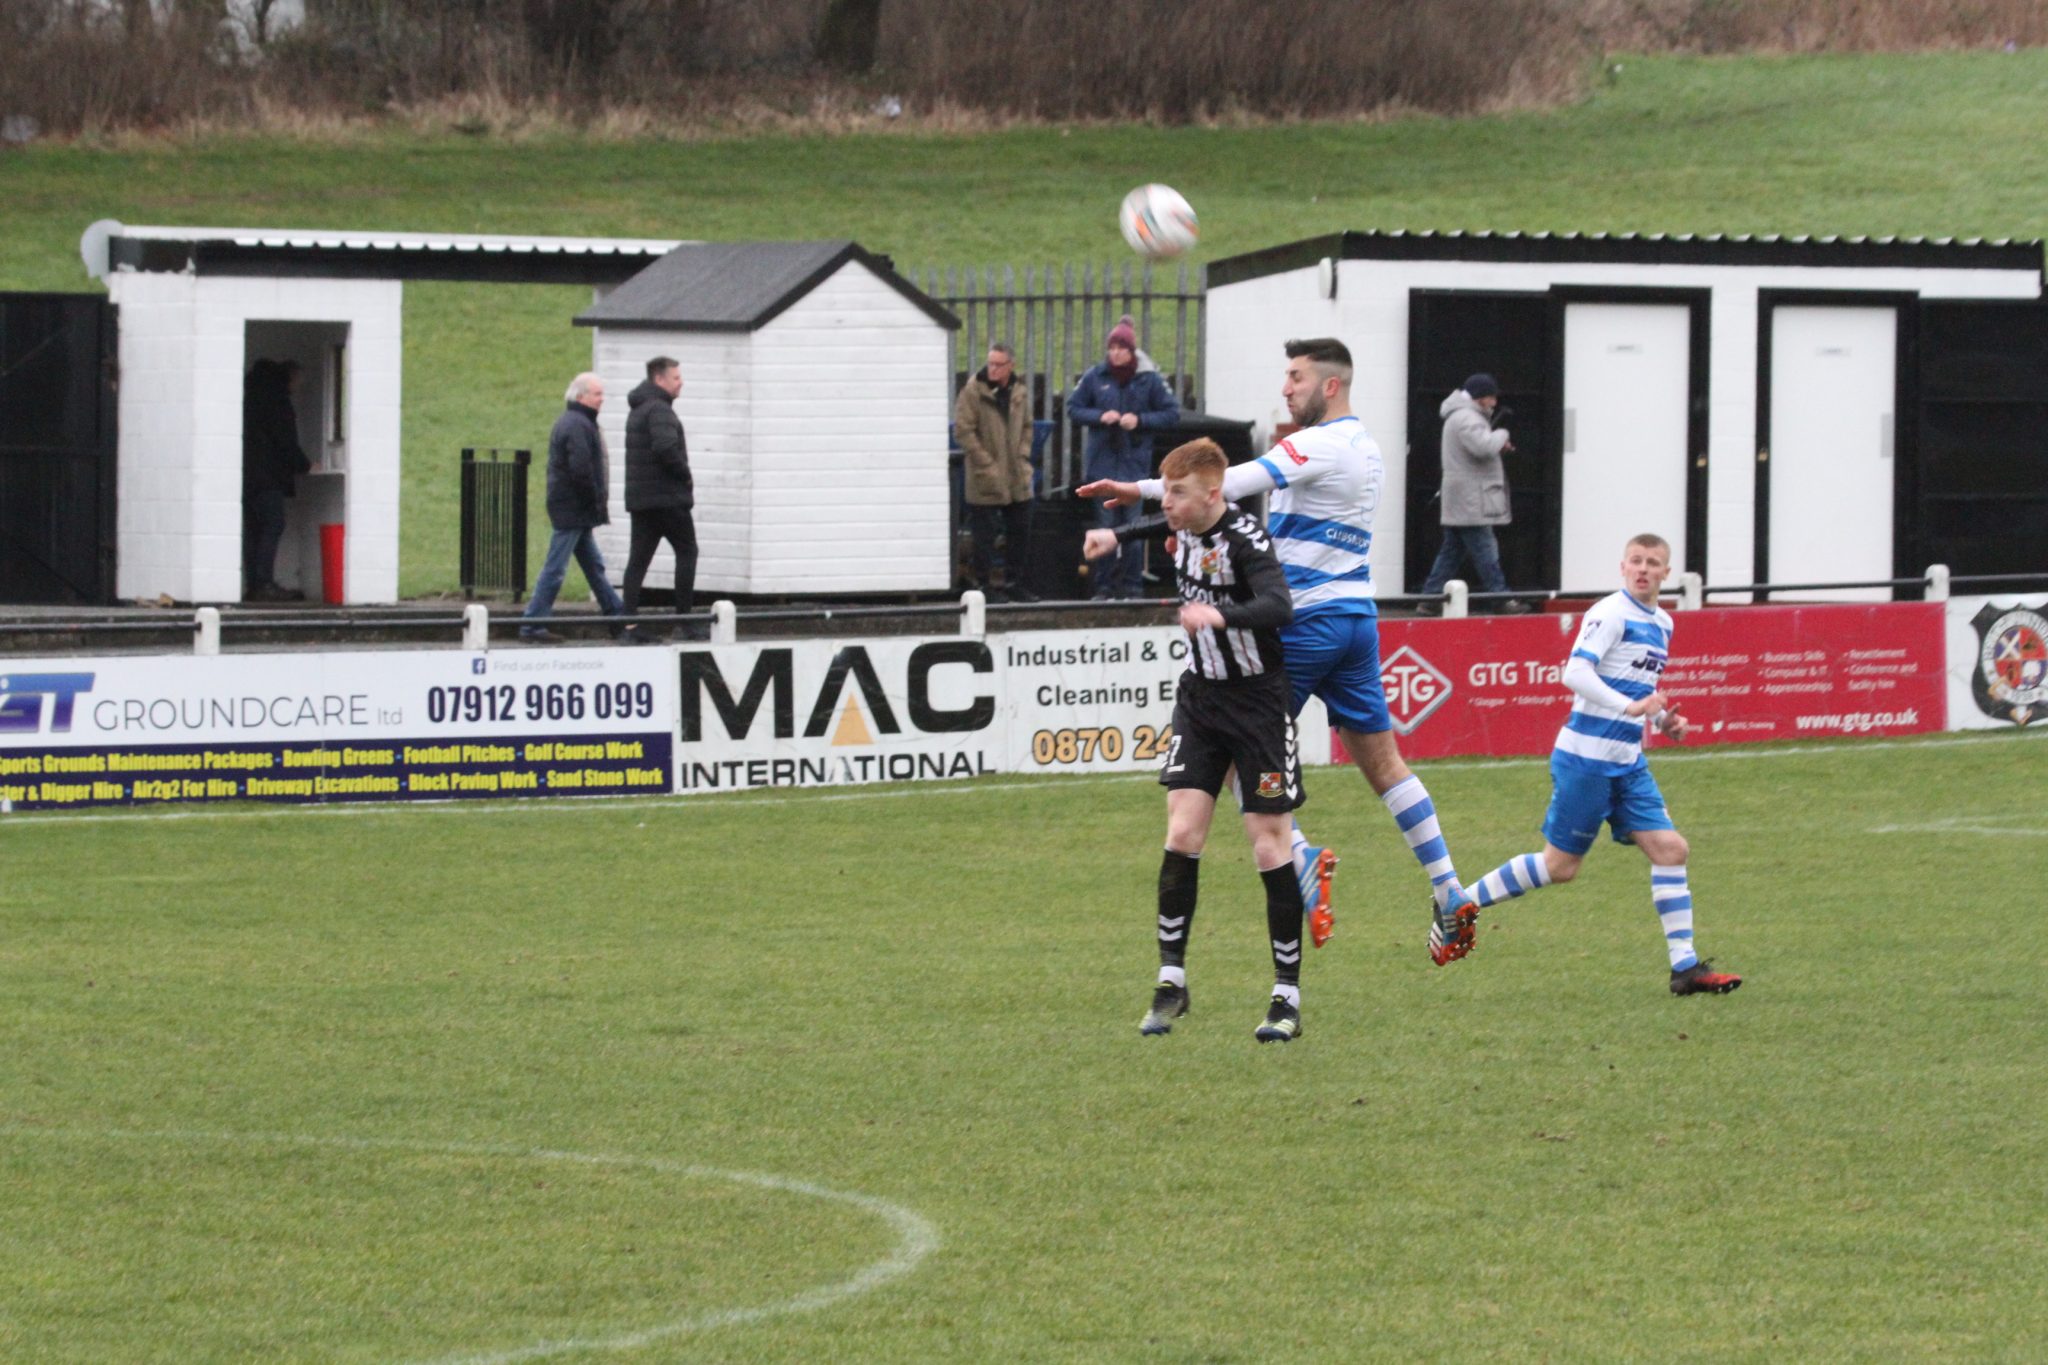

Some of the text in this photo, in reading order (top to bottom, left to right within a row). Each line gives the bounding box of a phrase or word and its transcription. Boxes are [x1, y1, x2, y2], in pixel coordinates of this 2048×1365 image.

[552, 658, 604, 670] Facebook
[1008, 641, 1130, 667] Industrial
[1141, 640, 1158, 662] &
[1468, 662, 1518, 687] GTG
[428, 682, 653, 723] 07912 966 099
[679, 641, 995, 742] MAC
[1036, 684, 1148, 708] Cleaning
[93, 695, 403, 731] GROUNDCARE ltd
[1796, 707, 1919, 733] www.gtg.co.uk
[43, 754, 106, 772] Grounds
[108, 753, 201, 771] Maintenance
[204, 751, 272, 770] Packages
[283, 749, 341, 768] Bowling
[343, 748, 394, 766] Greens
[404, 746, 460, 764] Football
[463, 745, 515, 763] Pitches
[525, 744, 553, 761] Golf
[555, 743, 604, 760] Course
[606, 741, 643, 759] Work
[1032, 726, 1123, 765] 0870
[28, 785, 39, 801] &
[41, 782, 91, 802] Digger
[93, 781, 123, 799] Hire
[183, 779, 205, 797] For
[207, 779, 236, 797] Hire
[248, 777, 312, 796] Driveway
[315, 775, 398, 794] Excavations
[409, 773, 449, 791] Block
[451, 773, 498, 791] Paving
[500, 771, 537, 789] Work
[548, 770, 582, 788] Sand
[585, 769, 624, 787] Stone
[626, 768, 663, 786] Work
[681, 751, 997, 788] INTERNATIONAL
